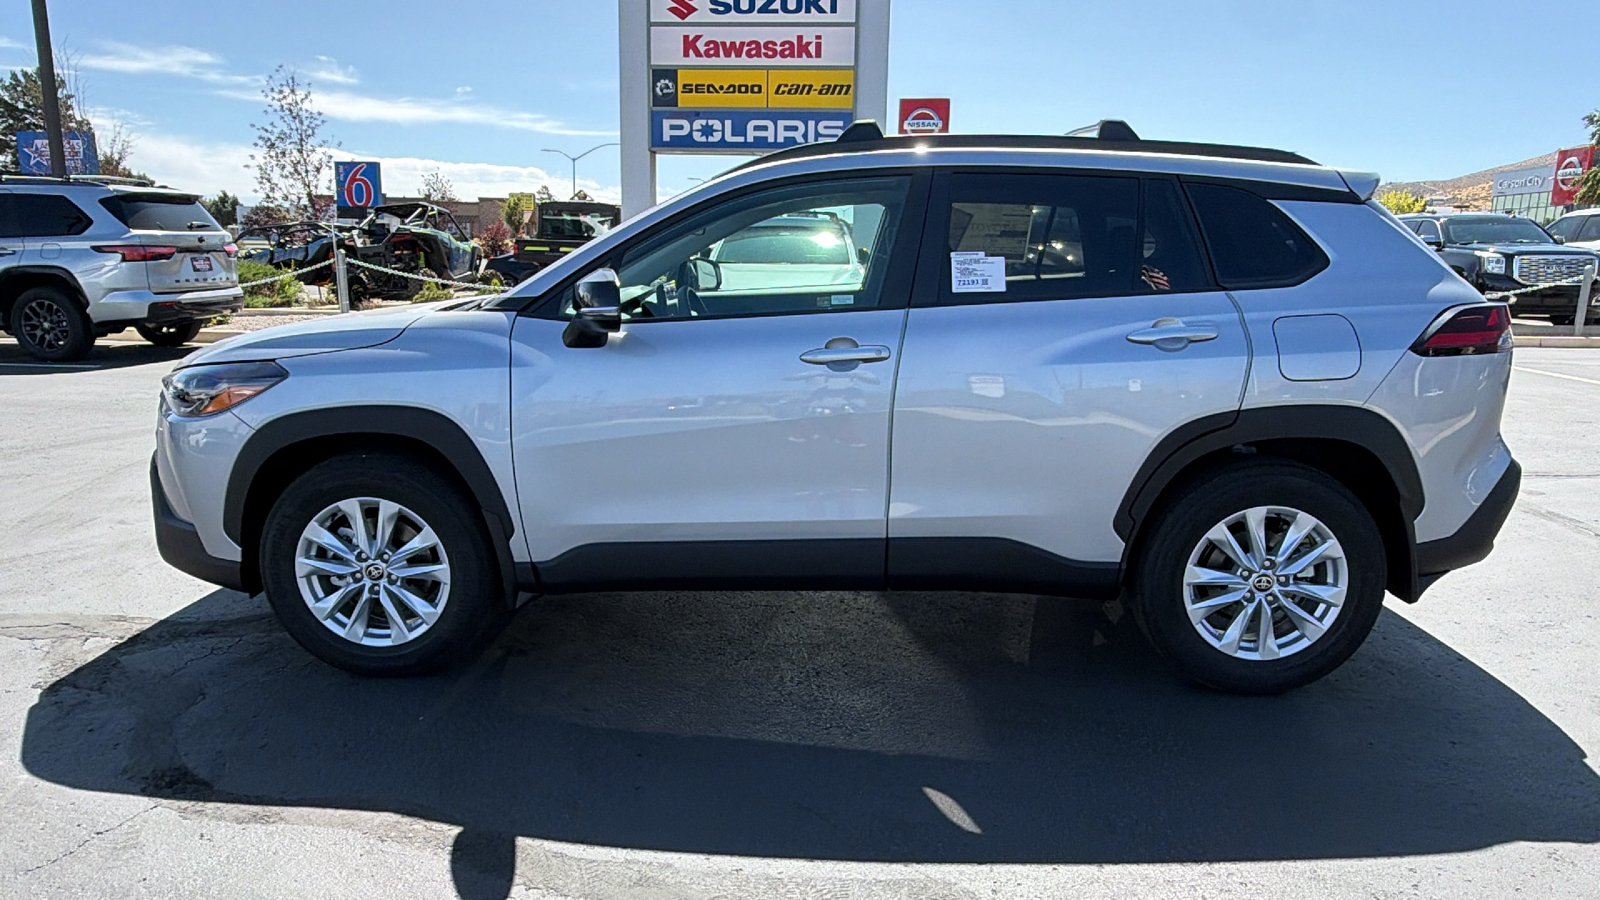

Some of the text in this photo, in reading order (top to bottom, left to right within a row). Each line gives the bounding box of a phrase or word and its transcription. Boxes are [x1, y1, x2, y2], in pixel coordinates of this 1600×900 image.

[708, 0, 838, 15] SUZUKI
[682, 34, 823, 59] Kawasaki
[662, 118, 845, 143] POLARIS
[344, 163, 374, 208] 6
[1497, 175, 1543, 189] Carson City
[956, 278, 980, 286] 72191
